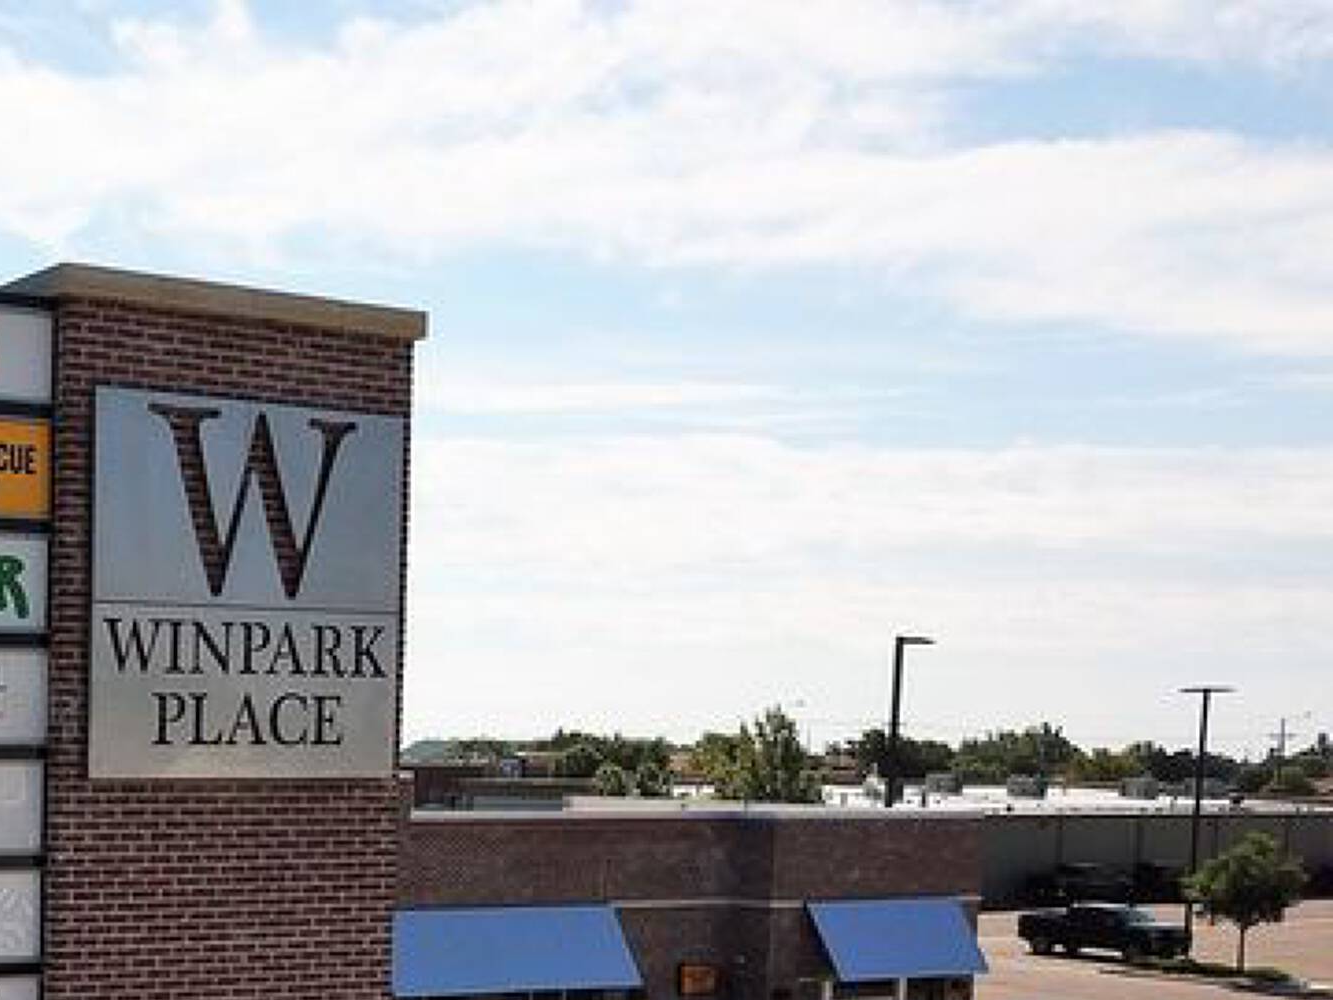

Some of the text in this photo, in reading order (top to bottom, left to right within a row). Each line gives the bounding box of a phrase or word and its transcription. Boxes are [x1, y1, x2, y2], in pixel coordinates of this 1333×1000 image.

[148, 403, 356, 599] W
[103, 618, 387, 678] WINPARK
[151, 692, 344, 746] PLACE
